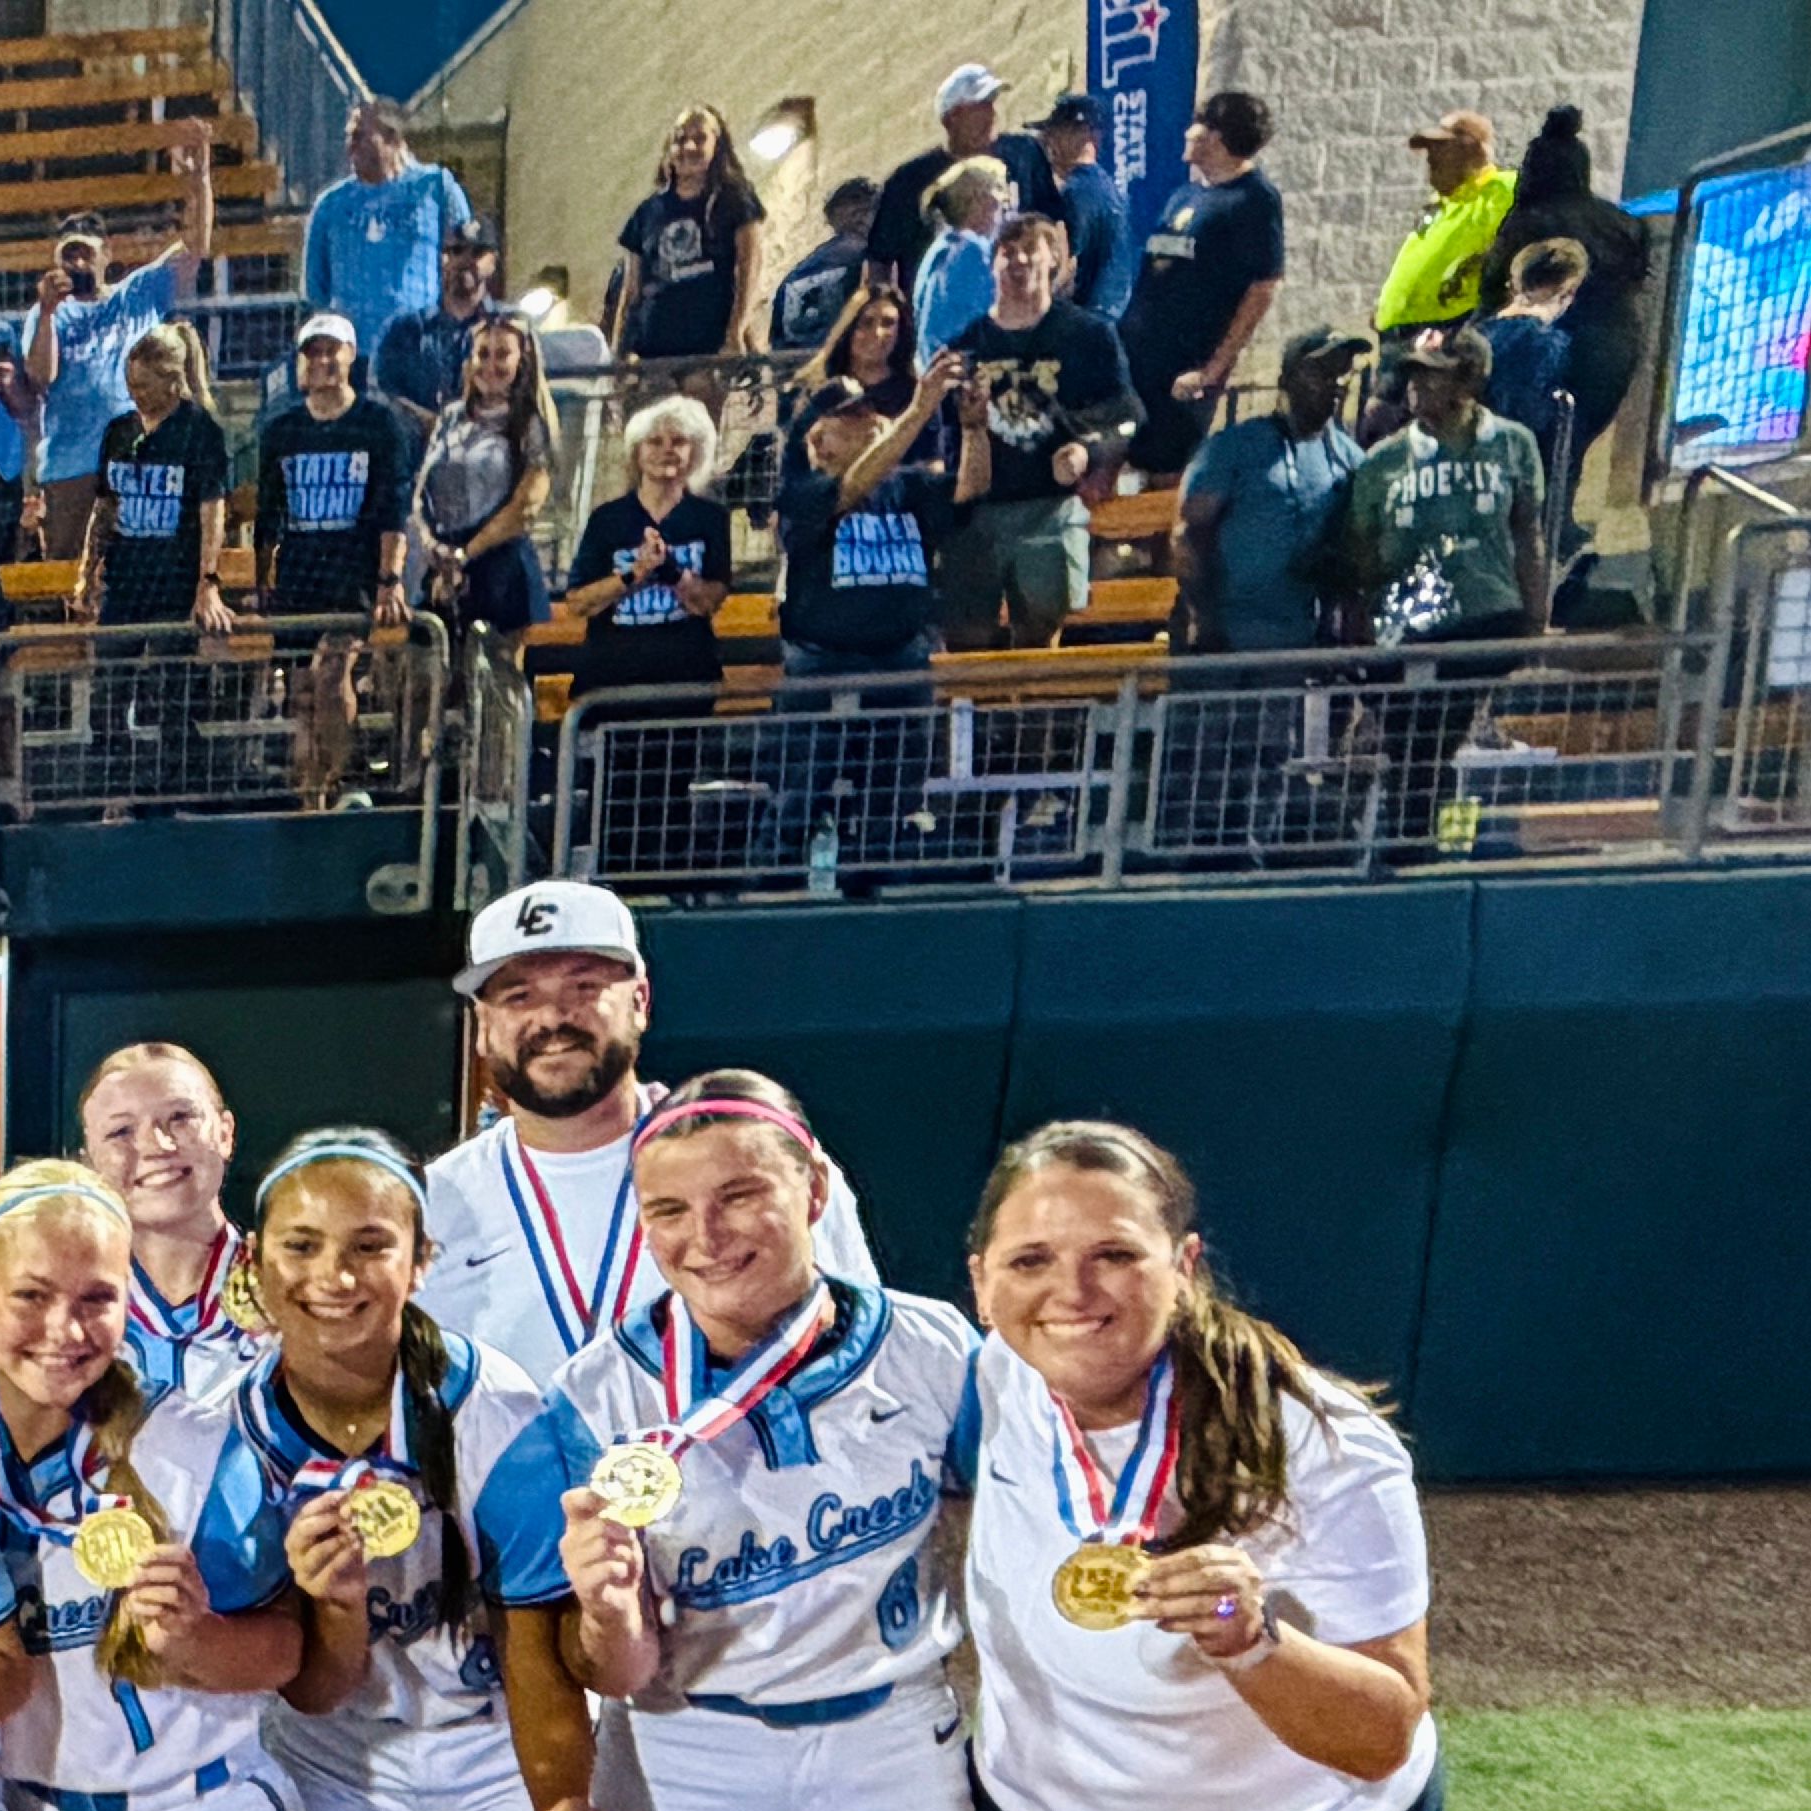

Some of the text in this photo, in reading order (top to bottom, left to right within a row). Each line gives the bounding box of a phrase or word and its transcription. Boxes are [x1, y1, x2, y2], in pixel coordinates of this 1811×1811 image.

[1385, 460, 1505, 514] PHOENIX
[677, 1459, 939, 1597] Lake Creek
